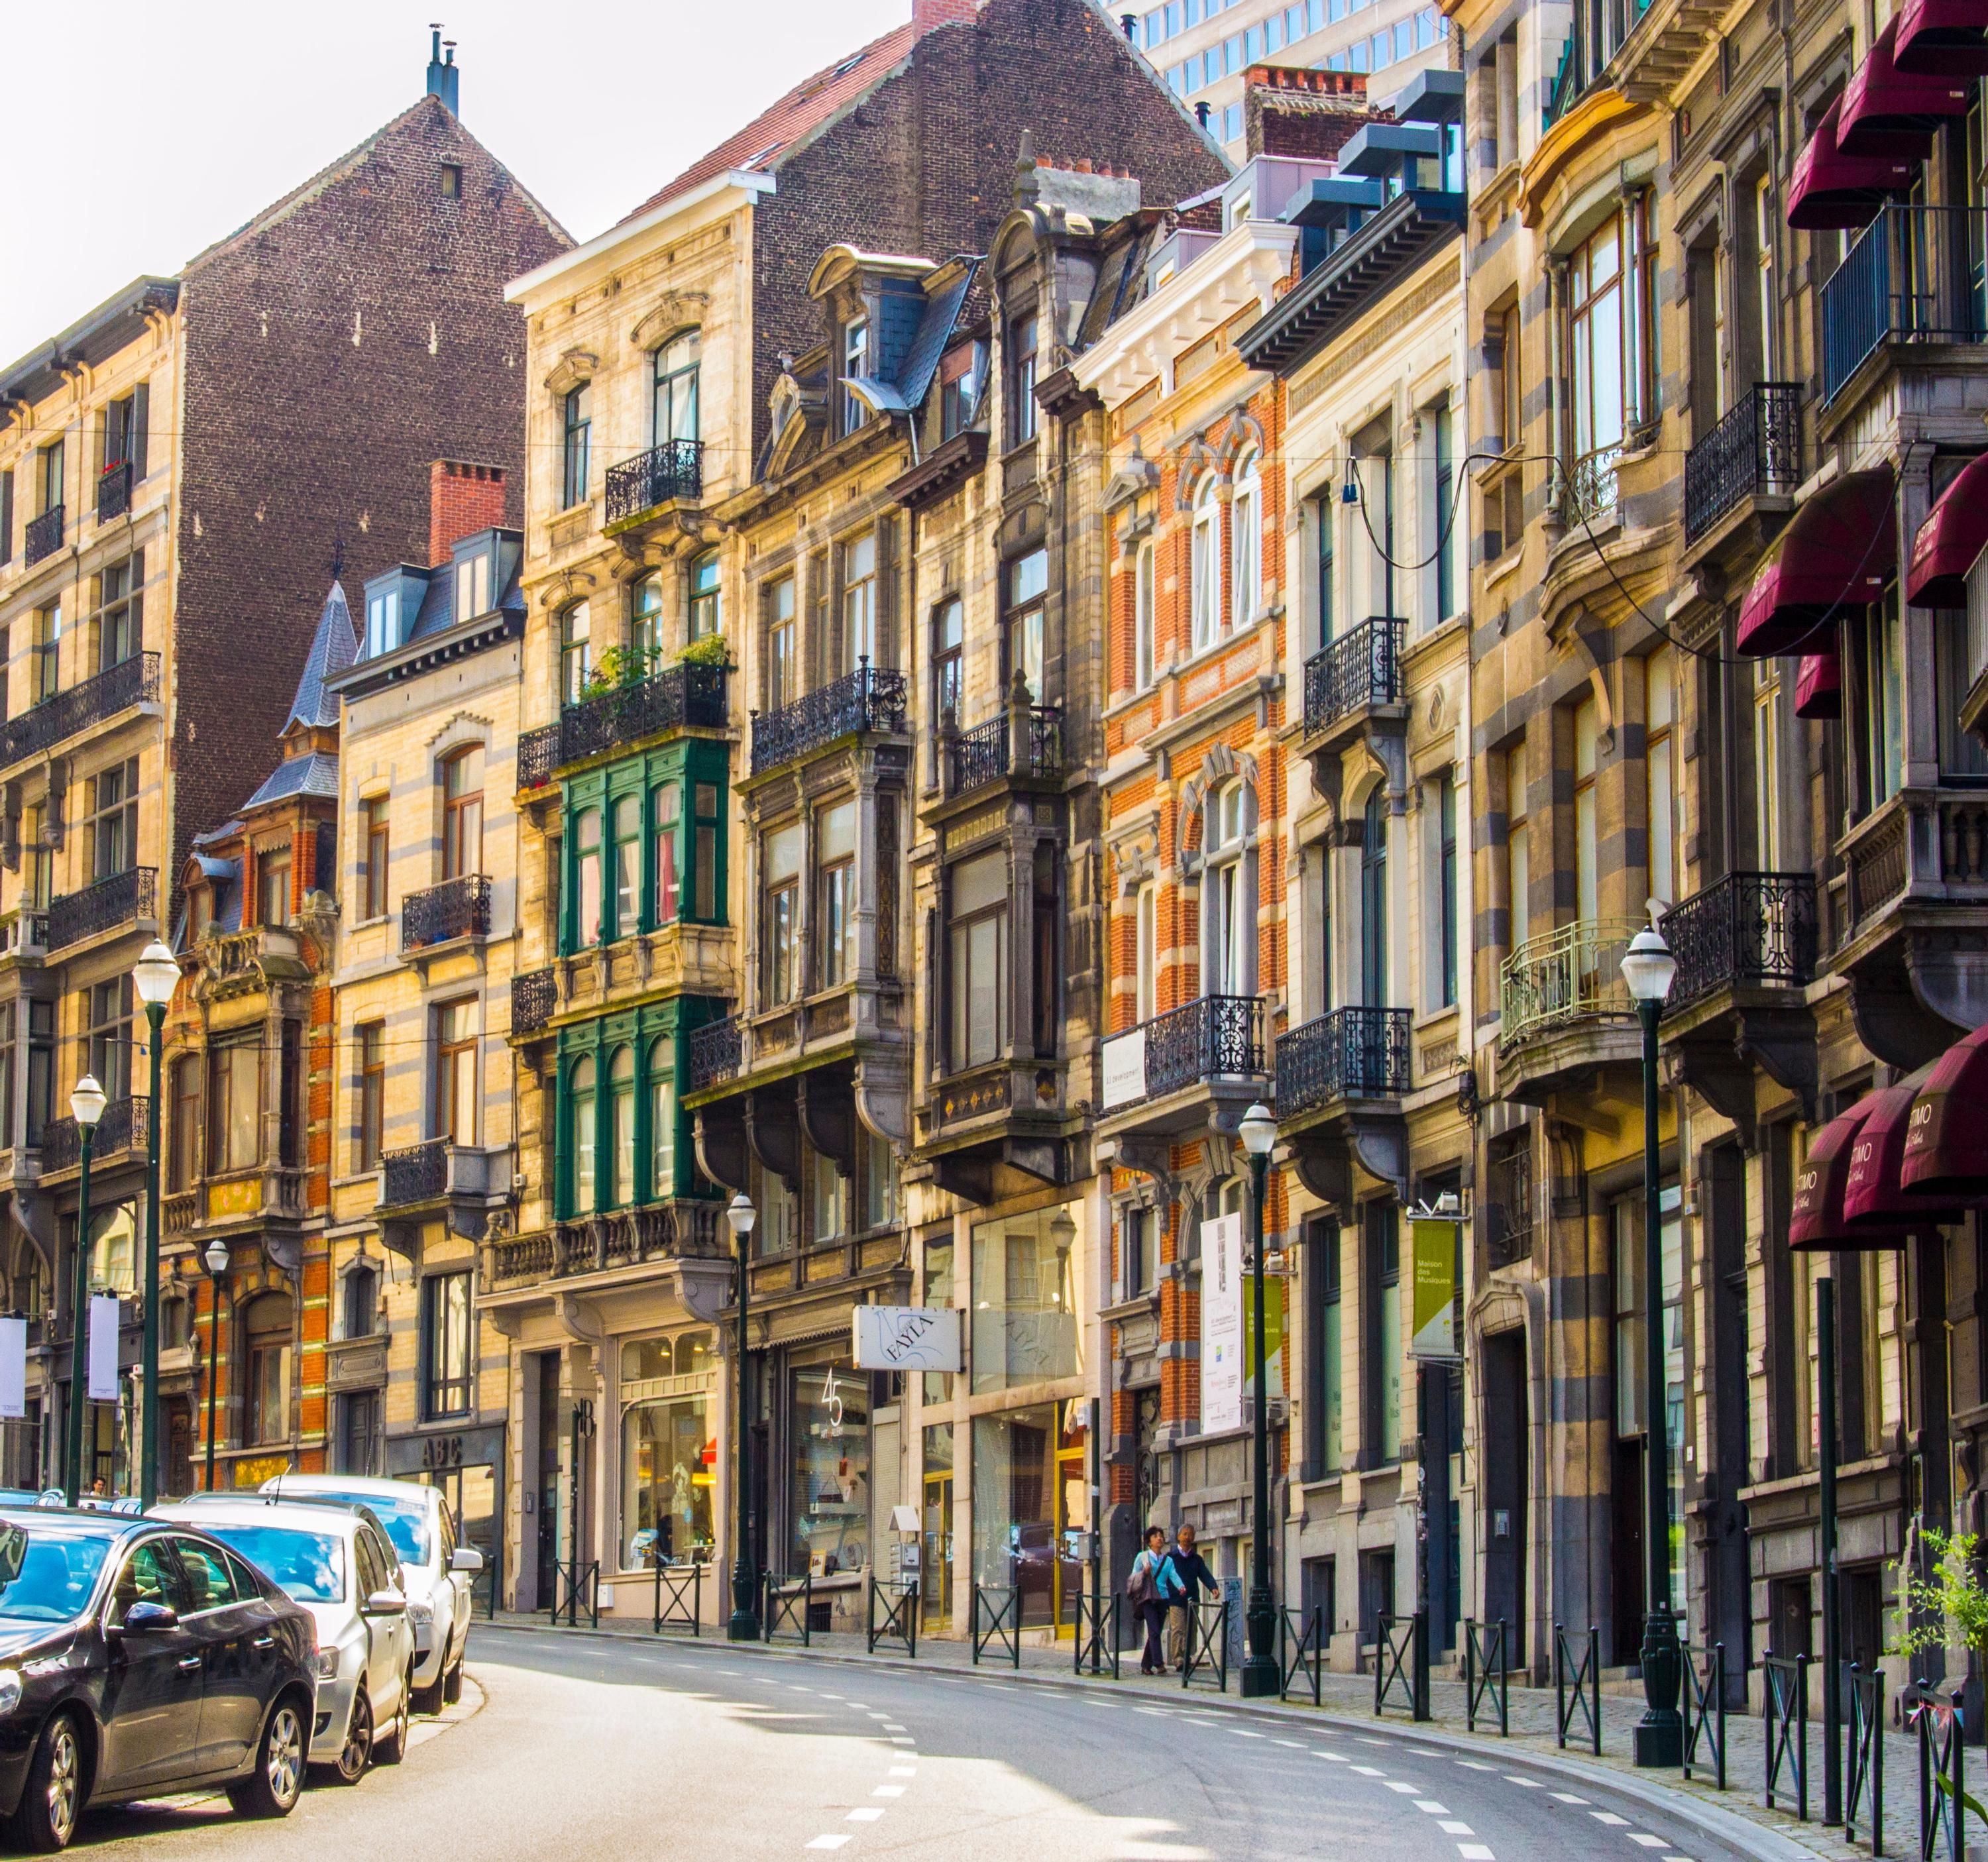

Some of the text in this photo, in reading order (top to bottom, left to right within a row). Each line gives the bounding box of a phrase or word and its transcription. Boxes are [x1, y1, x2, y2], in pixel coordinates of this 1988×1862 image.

[1418, 1276, 1451, 1285] Musiques
[887, 1317, 934, 1360] FAYLA
[822, 1367, 842, 1427] 45
[423, 1435, 463, 1466] ABC
